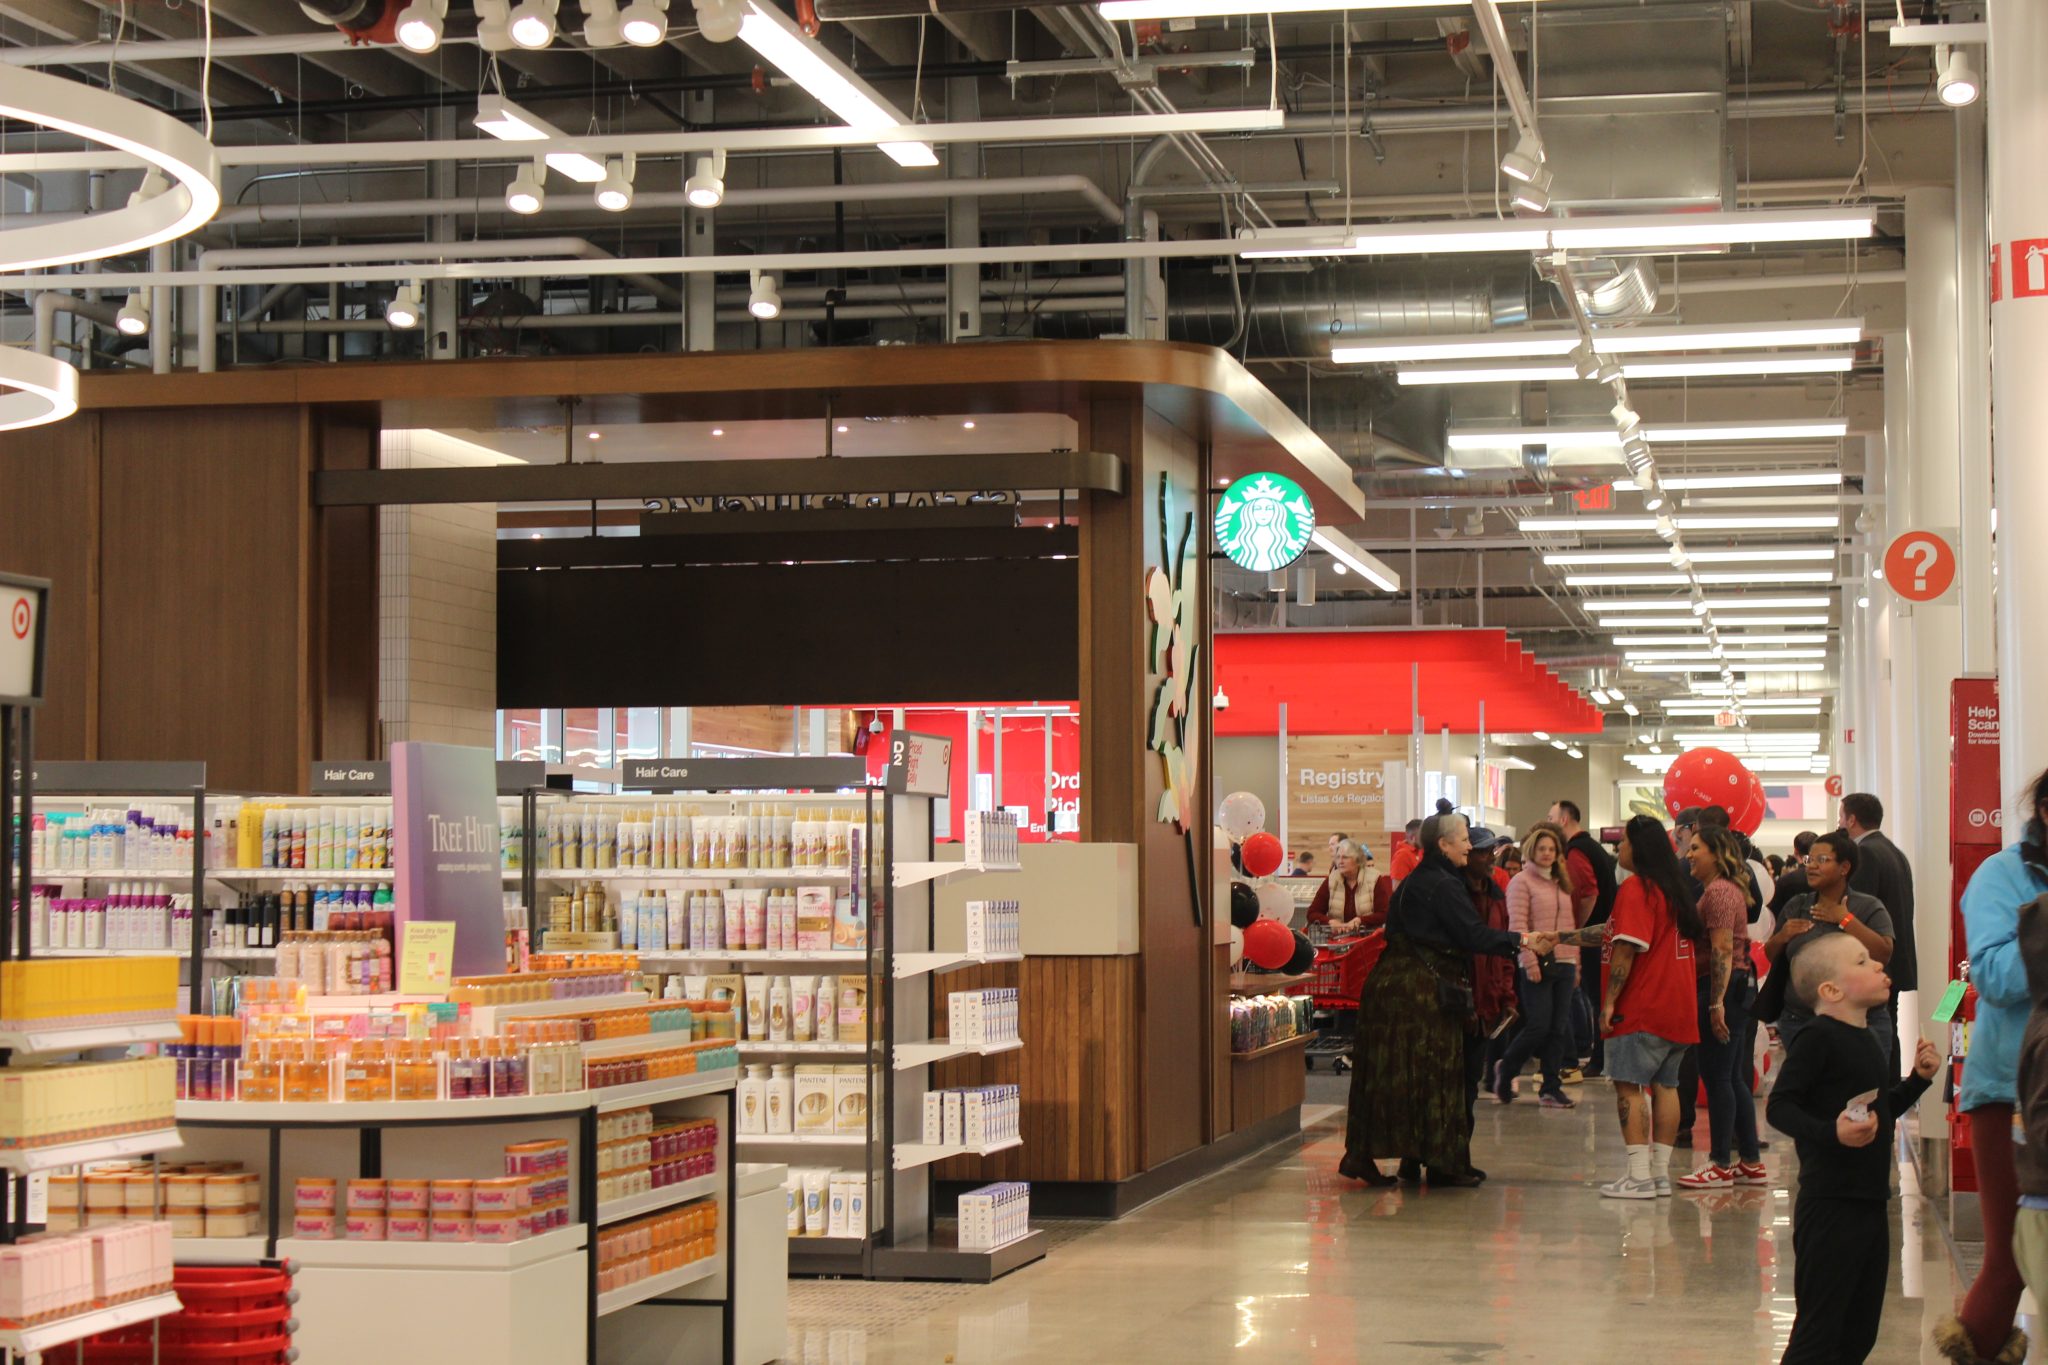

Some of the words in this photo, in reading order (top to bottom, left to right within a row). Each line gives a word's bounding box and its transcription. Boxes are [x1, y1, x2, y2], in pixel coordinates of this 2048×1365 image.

[1968, 706, 1997, 719] Help
[1968, 719, 1999, 730] Scan
[893, 740, 904, 753] D
[893, 754, 903, 766] 2
[13, 770, 38, 780] Ce
[324, 770, 347, 780] Hair
[348, 770, 375, 780] Care
[635, 767, 659, 778] Hair
[660, 767, 688, 778] Care
[1300, 768, 1384, 789] Registry
[1300, 794, 1329, 804] Listas
[1332, 794, 1345, 804] de
[428, 814, 463, 852] TREE
[465, 815, 495, 853] HUT
